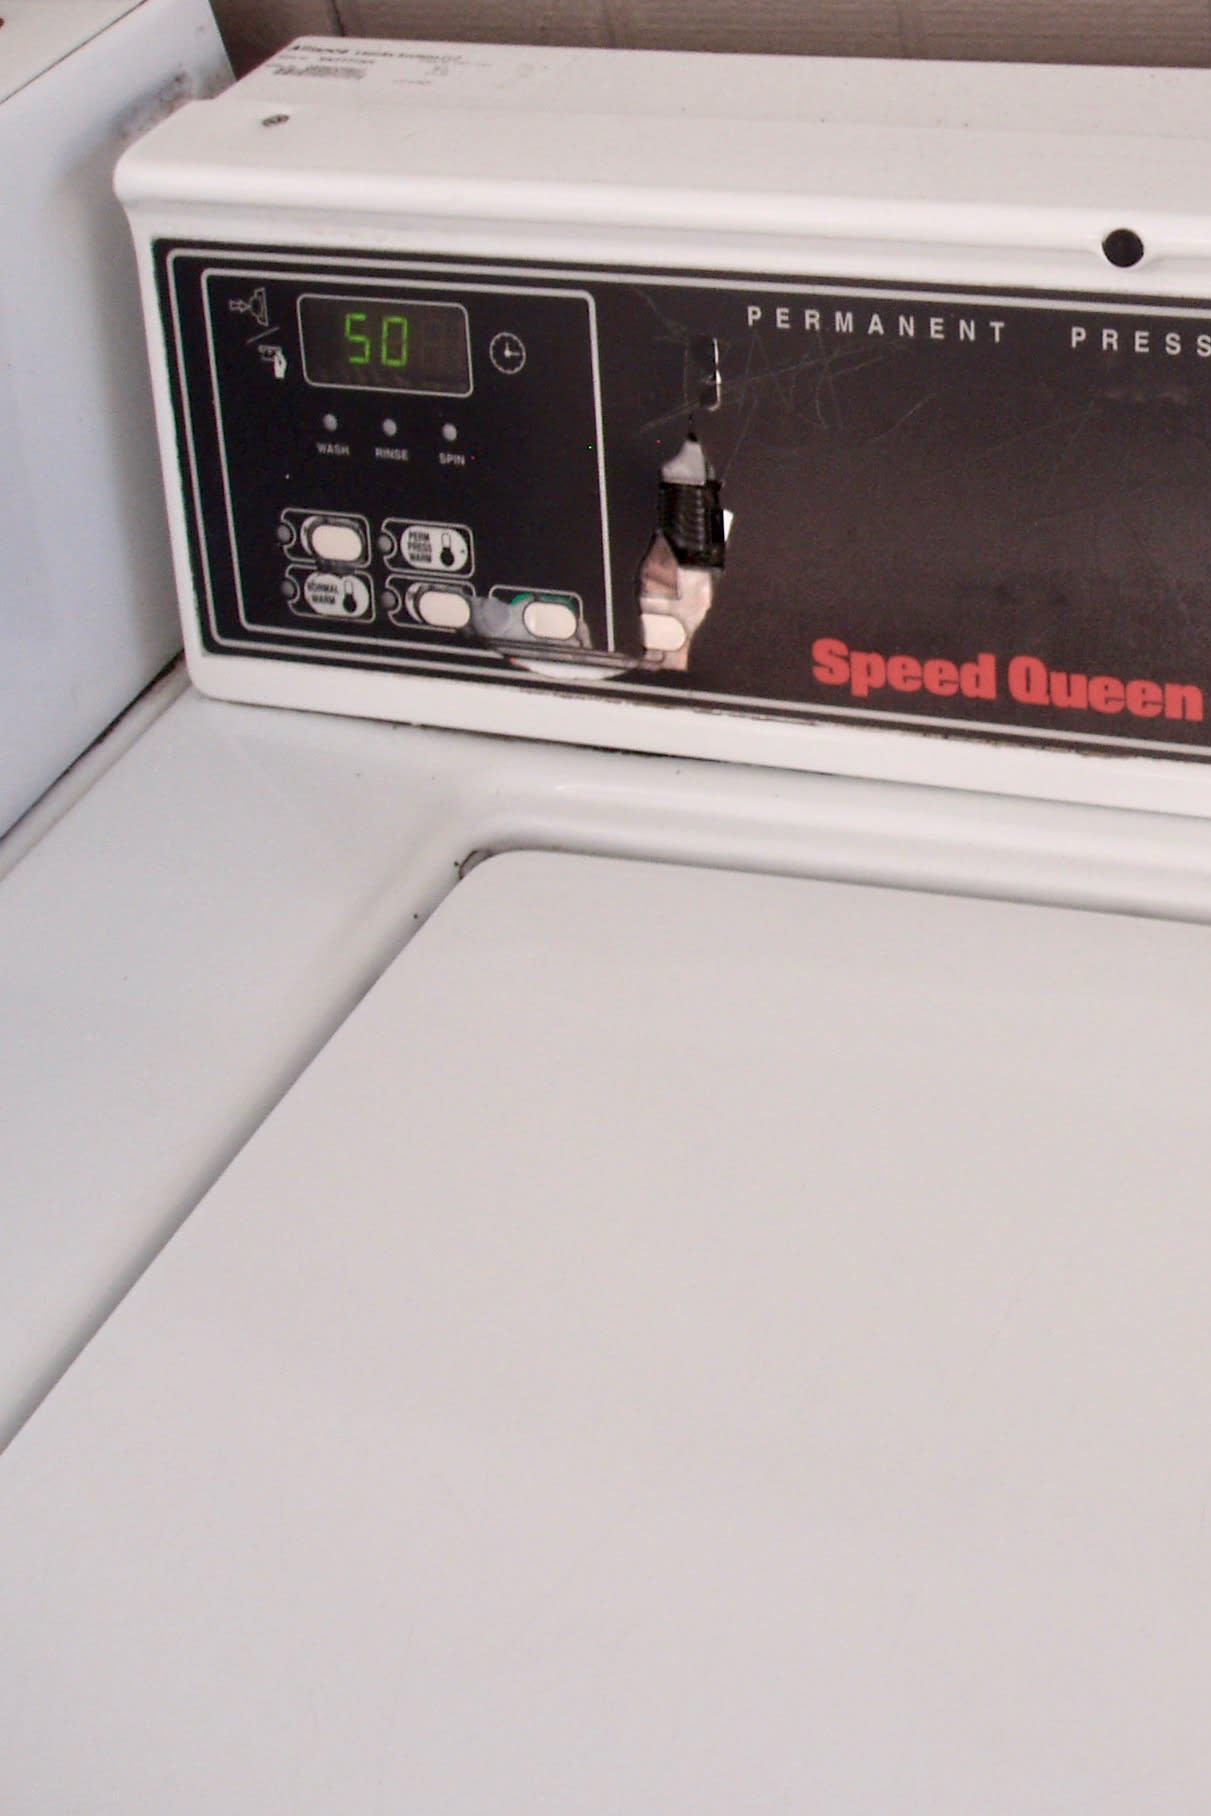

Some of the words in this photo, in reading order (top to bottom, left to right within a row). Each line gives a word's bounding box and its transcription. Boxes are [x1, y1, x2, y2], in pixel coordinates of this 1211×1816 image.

[747, 305, 1005, 344] PERMANENT
[344, 312, 408, 367] 50
[316, 441, 350, 455] WASH
[375, 447, 409, 461] RINSE
[438, 452, 466, 466] SPIN
[810, 637, 997, 700] Speed
[1008, 655, 1204, 723] Queen
